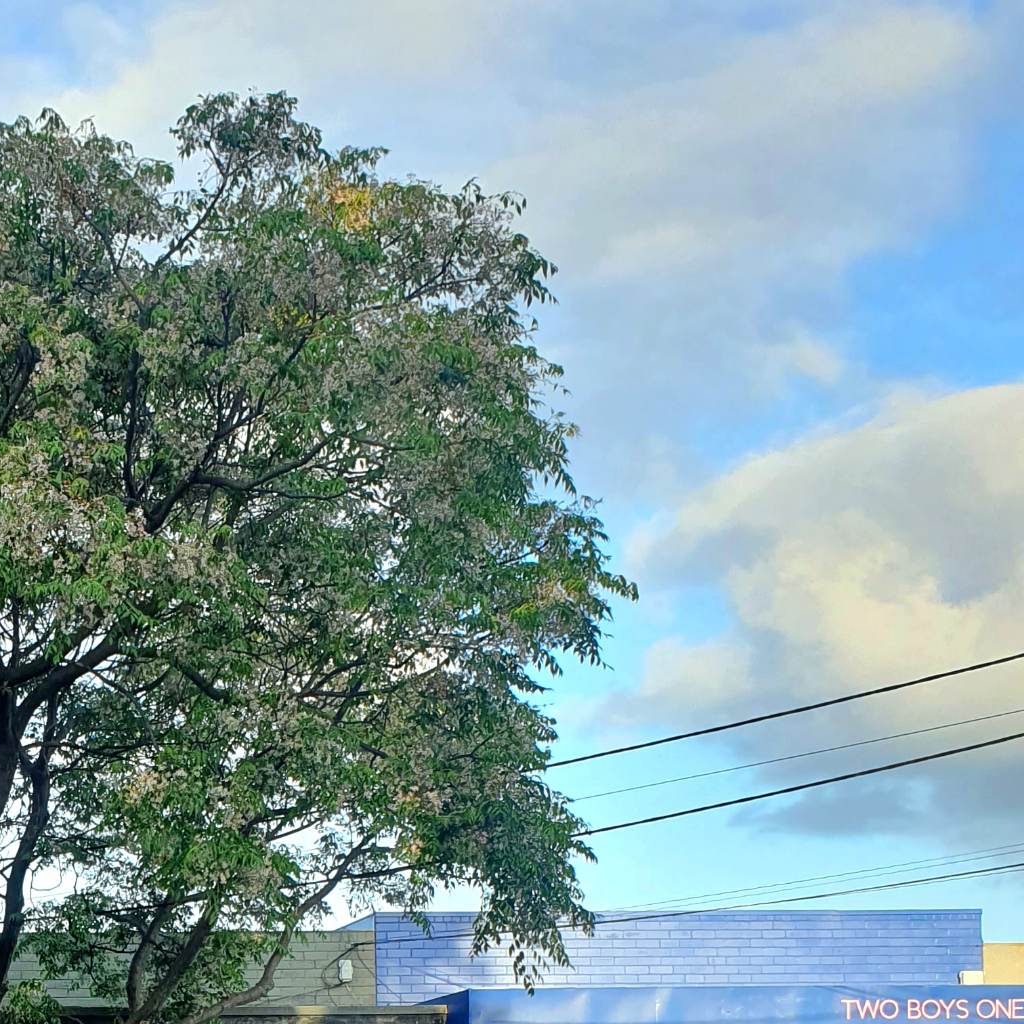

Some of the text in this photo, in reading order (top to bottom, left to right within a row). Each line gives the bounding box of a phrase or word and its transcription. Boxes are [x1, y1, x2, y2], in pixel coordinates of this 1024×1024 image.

[841, 999, 1024, 1020] TWO BOYS ONE
